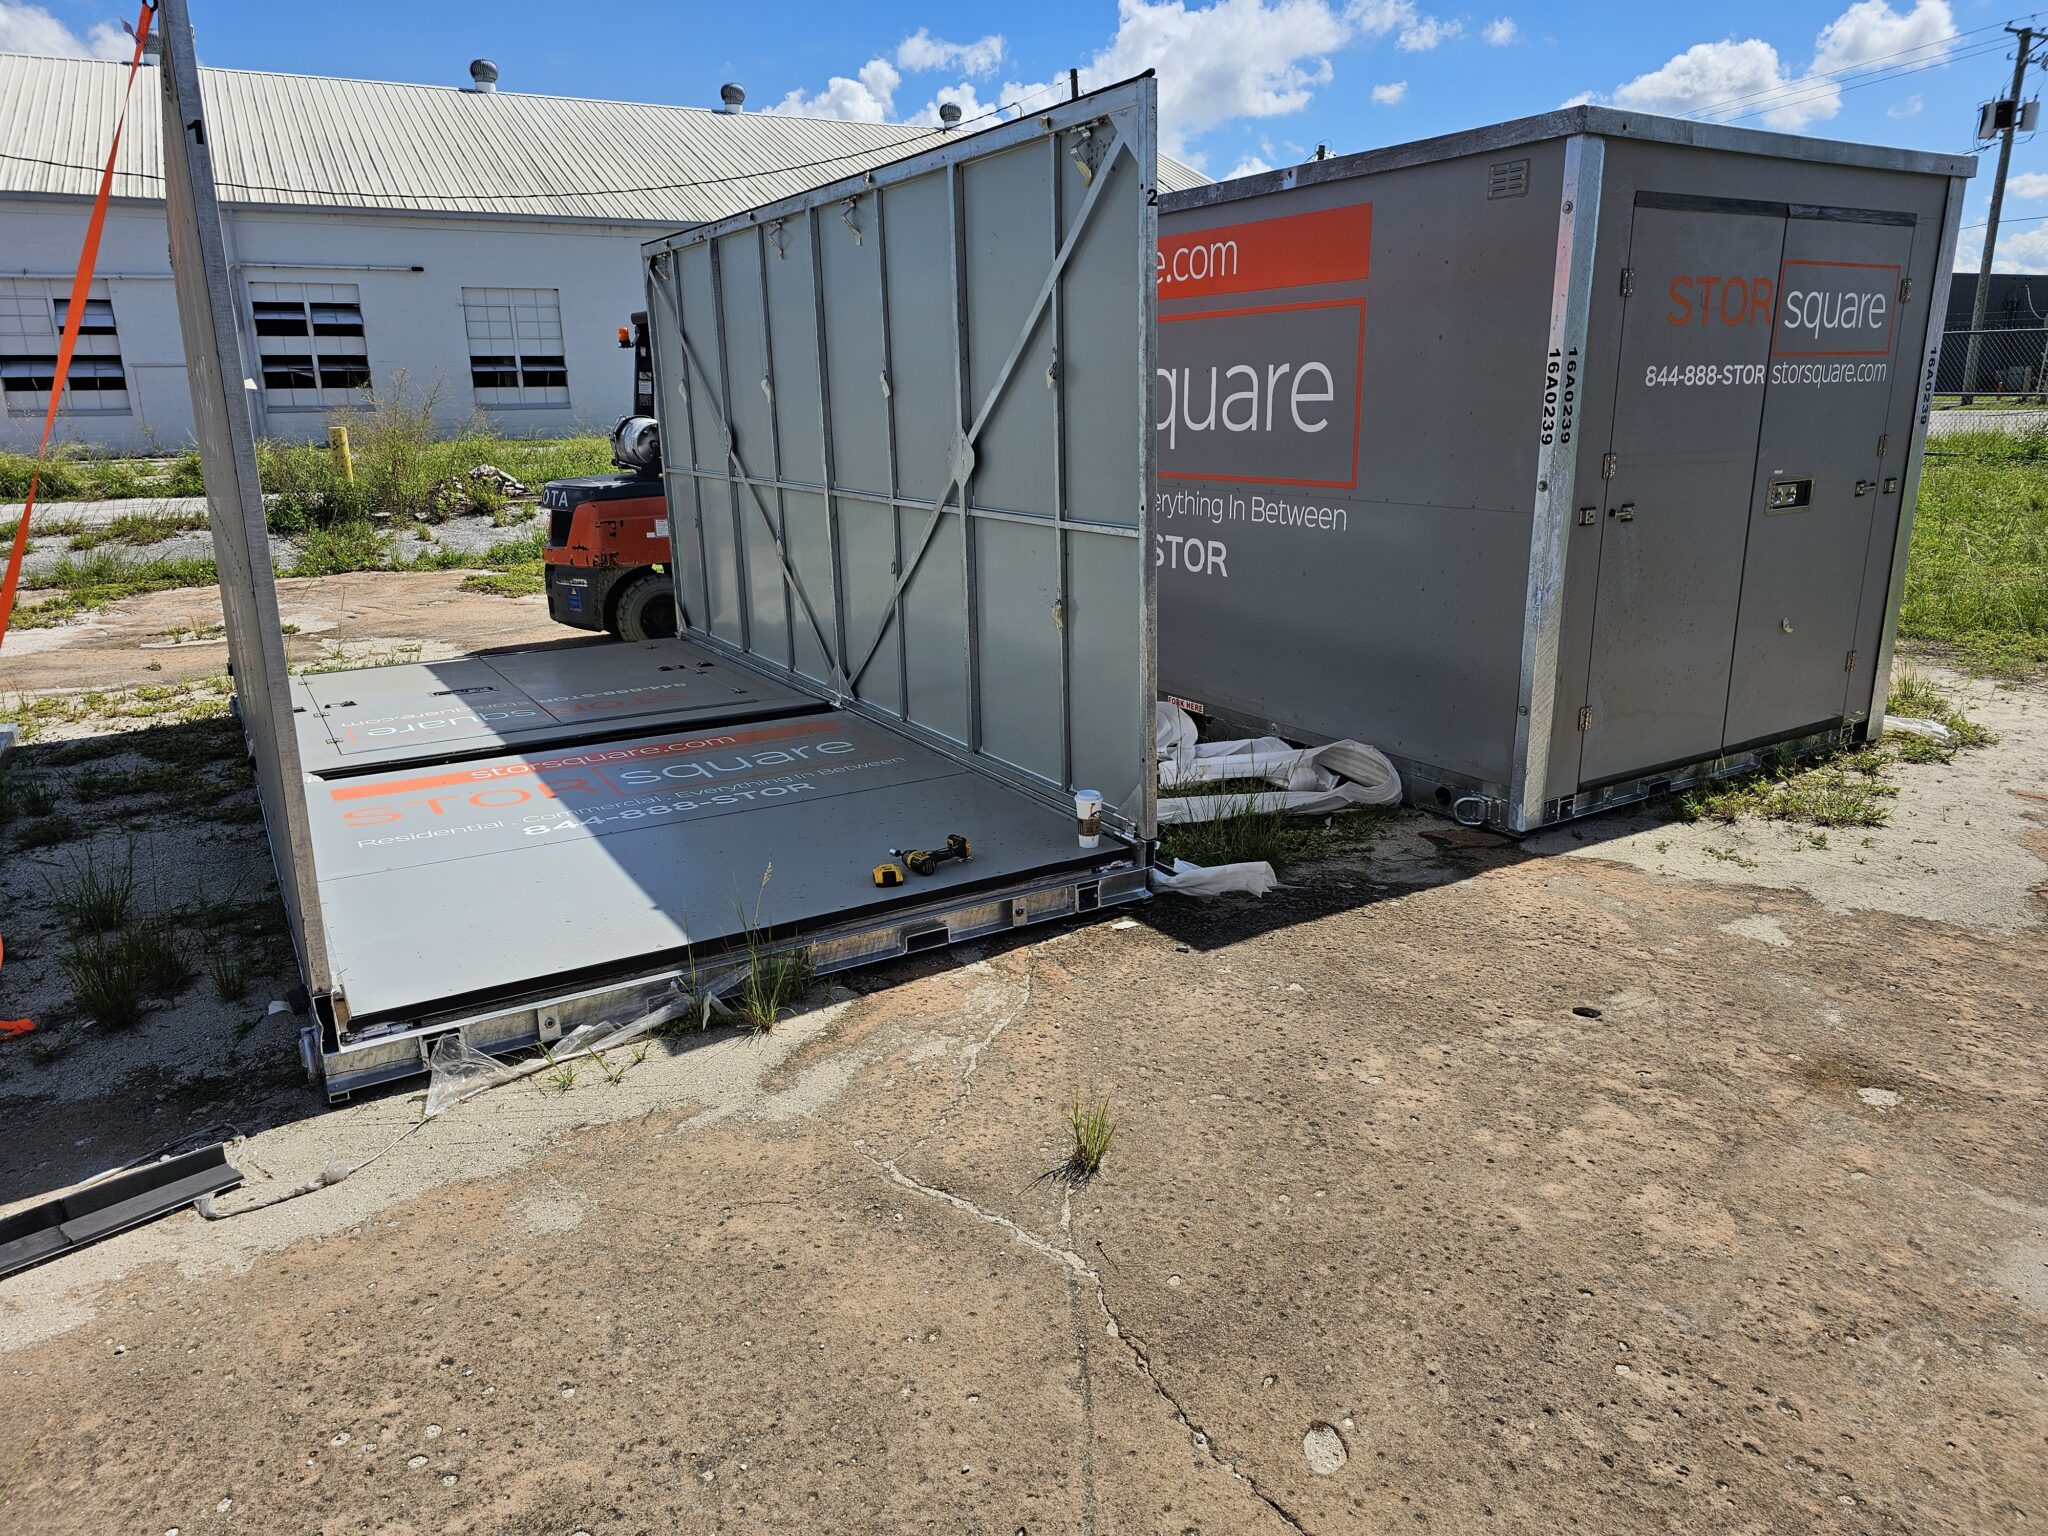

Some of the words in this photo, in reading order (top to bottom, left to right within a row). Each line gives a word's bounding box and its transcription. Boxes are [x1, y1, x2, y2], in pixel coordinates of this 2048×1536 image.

[187, 120, 204, 145] 1
[1146, 188, 1158, 206] 2
[1667, 275, 1775, 327] STOR
[1784, 290, 1886, 339] square
[1541, 348, 1561, 445] 16A0239
[1560, 347, 1578, 444] 16A0239
[1645, 364, 1766, 387] 844-888-STOR
[1771, 360, 1887, 389] storsquare.com
[1229, 494, 1245, 521] In
[1251, 496, 1347, 531] Between
[1186, 701, 1204, 713] HERE
[471, 735, 736, 779] storsquare.com
[619, 740, 857, 785] square
[341, 777, 599, 827] STOR
[357, 819, 505, 848] Residential
[522, 795, 662, 823] Commercial
[674, 773, 793, 799] Everything
[797, 769, 815, 781] In
[817, 756, 907, 777] Between
[522, 782, 818, 836] 844-888-STOR
